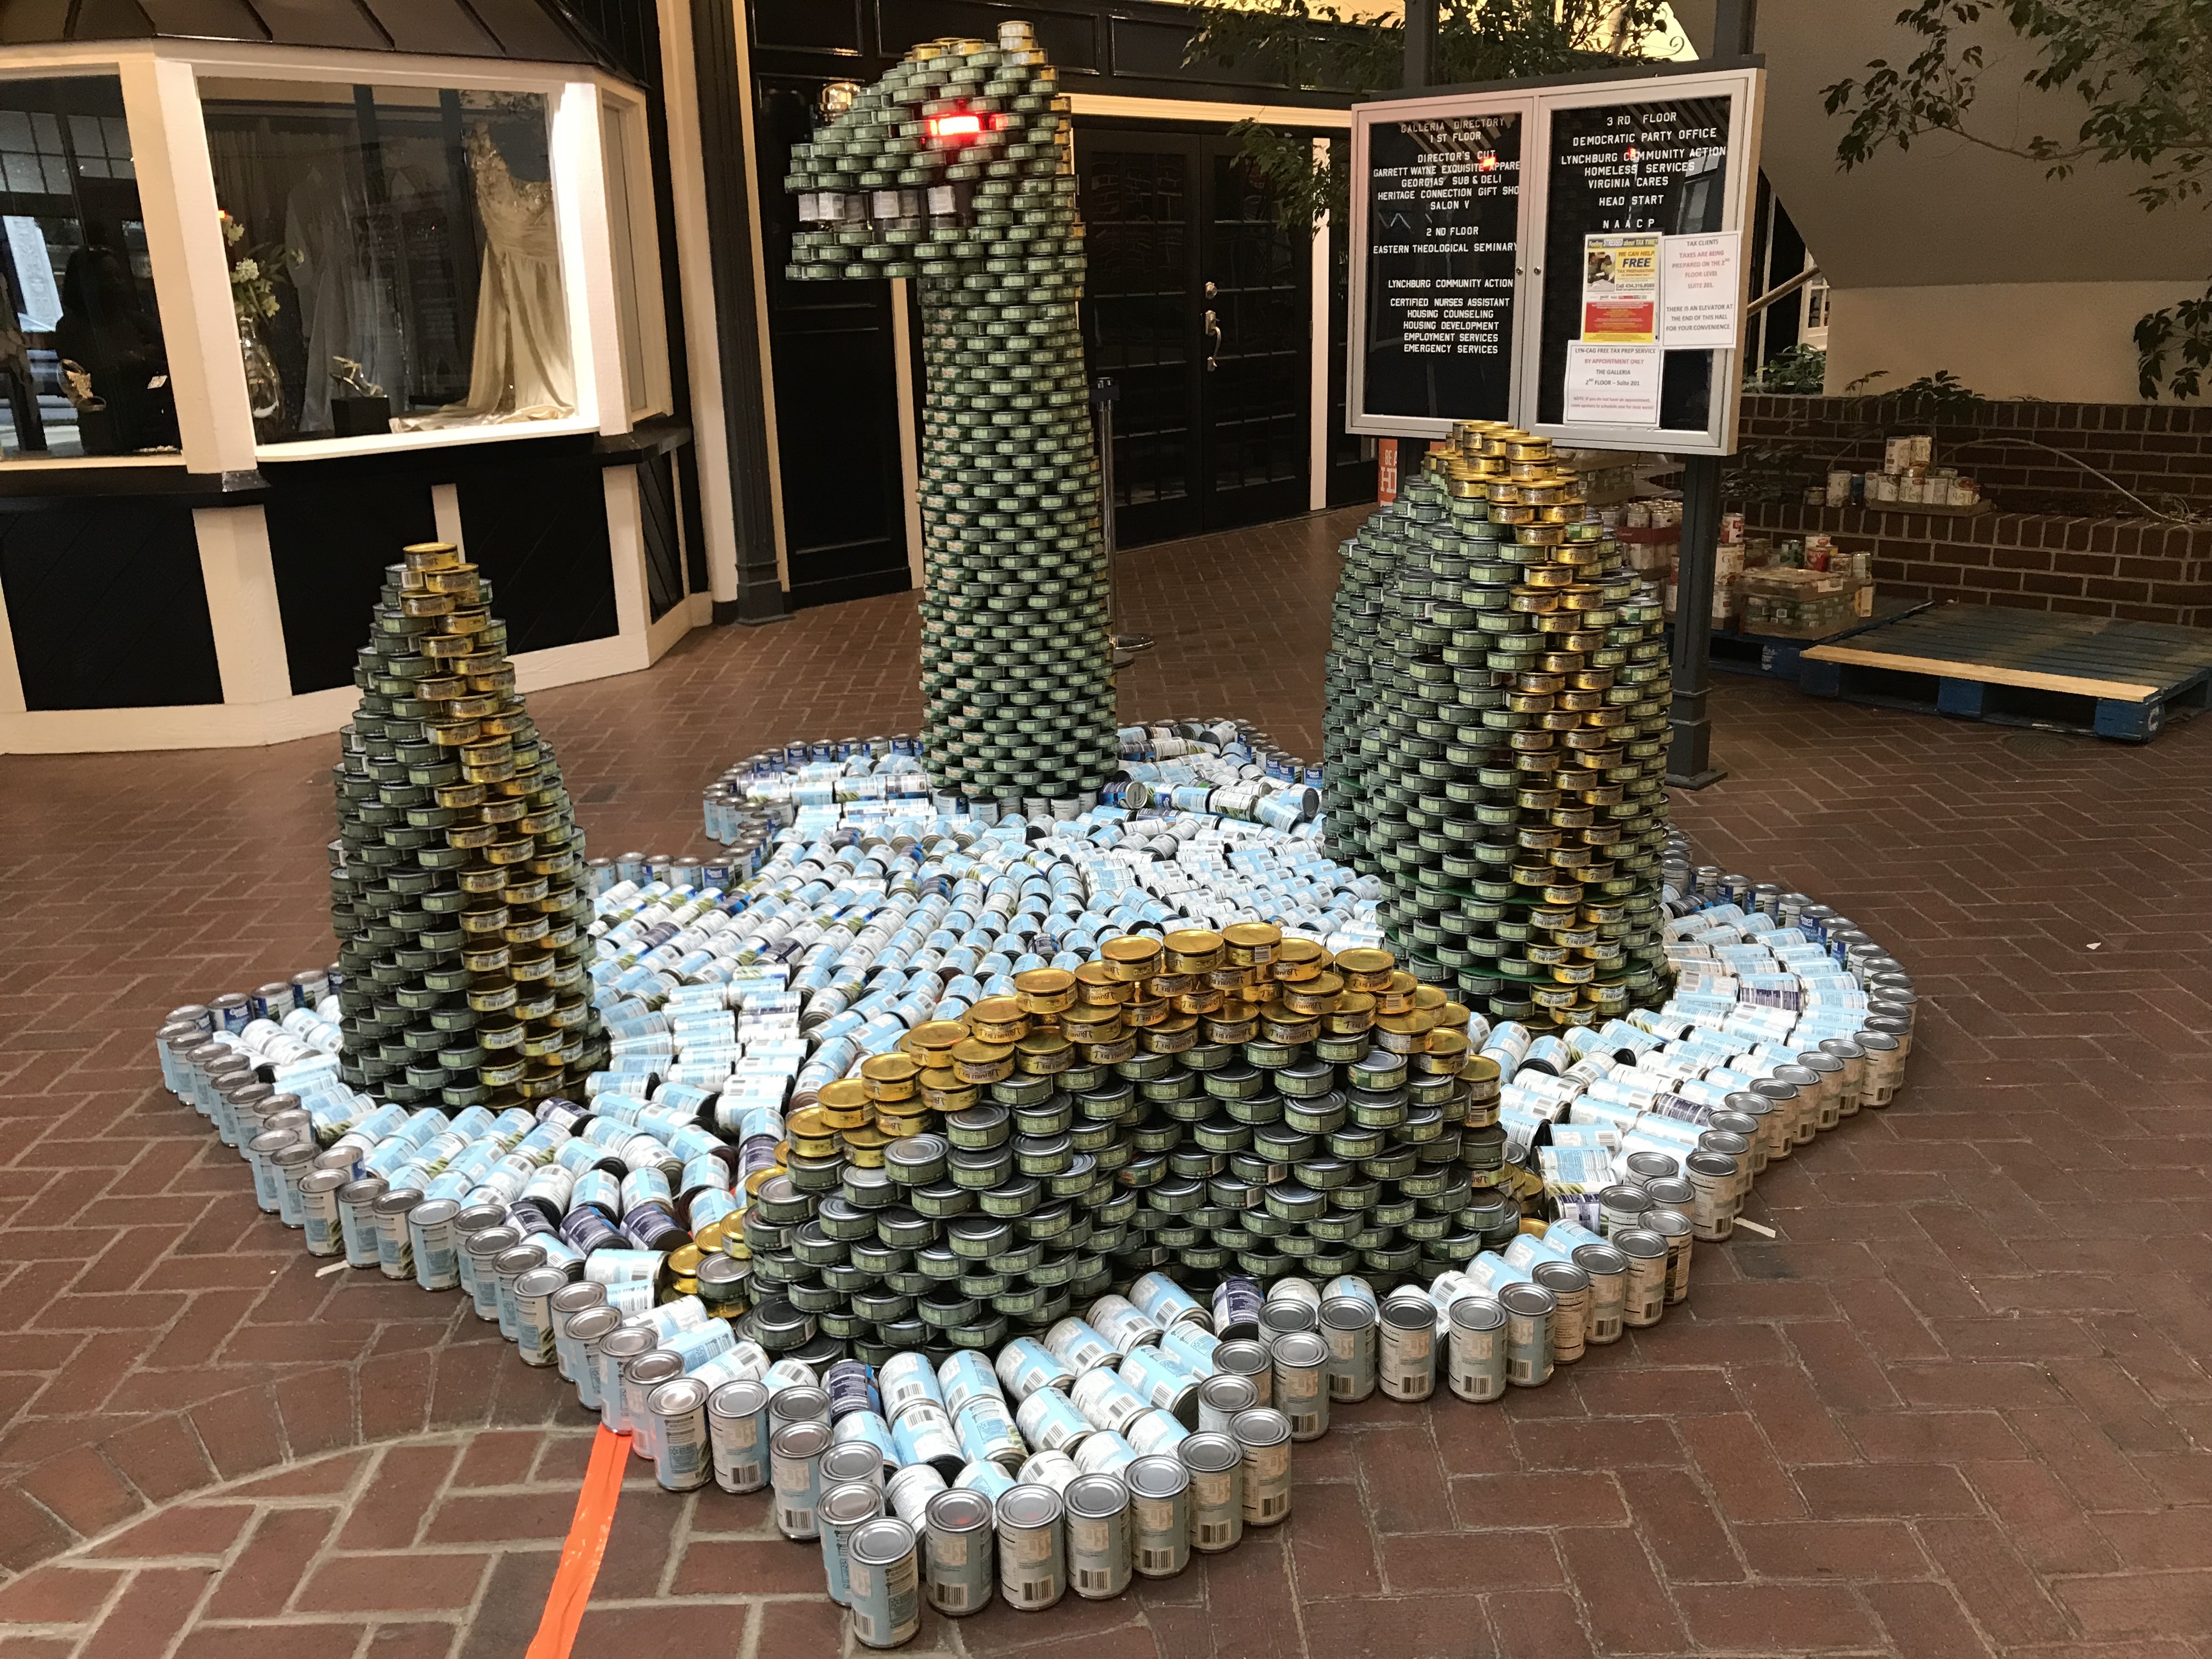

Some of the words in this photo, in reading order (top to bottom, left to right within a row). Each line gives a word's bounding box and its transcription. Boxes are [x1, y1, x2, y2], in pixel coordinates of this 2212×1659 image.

[1401, 122, 1444, 133] GALLERIA
[1454, 117, 1504, 129] DIRECTORY
[1607, 117, 1613, 126] 3
[1618, 116, 1630, 125] RD
[1643, 112, 1677, 124] FLOOR
[1437, 134, 1447, 143] ST
[1453, 131, 1481, 142] FLOOR
[1573, 134, 1635, 146] DEMOCRATIC
[1641, 131, 1672, 142] PARTY
[1679, 128, 1717, 139] OFFICE
[1418, 151, 1470, 163] DIRECTOR'S
[1477, 150, 1496, 160] CUT
[1561, 153, 1618, 165] LYNCHBURG
[1623, 149, 1685, 161] COMMUNITY
[1690, 146, 1726, 157] ACTION
[1374, 167, 1408, 177] GARRETT
[1410, 166, 1436, 175] WAYNE
[1442, 163, 1485, 173] EXQUISITE
[1585, 165, 1638, 176] HOMELESS
[1646, 162, 1695, 173] SERVICES
[1402, 177, 1443, 188] GEORGIAS
[1453, 176, 1469, 185] SUB
[1472, 176, 1478, 184] &
[1481, 174, 1501, 183] DELI
[1588, 178, 1630, 189] VIRGINIA
[1637, 176, 1668, 187] CARES
[1378, 191, 1415, 200] HERITAGE
[1421, 188, 1471, 199] CONNECTION
[1478, 187, 1497, 196] GIFT
[1431, 201, 1459, 210] SALON
[1465, 200, 1469, 208] V
[1599, 196, 1624, 206] HEAD
[1632, 195, 1664, 205] START
[1426, 228, 1431, 236] 2
[1436, 227, 1446, 236] ND
[1450, 226, 1479, 235] FLOOR
[1373, 245, 1409, 253] EASTERN
[1412, 244, 1468, 253] THEOLOGICAL
[1622, 258, 1651, 268] FREE
[1436, 279, 1481, 287] COMMUNITY
[1485, 279, 1513, 287] ACTION
[1467, 298, 1510, 307] ASSISTANT
[1408, 309, 1438, 318] HOUSING
[1444, 310, 1493, 318] COUNSELING
[1441, 321, 1499, 330] DEVELOPMENT
[1404, 333, 1455, 341] EMPLOYMENT
[1459, 334, 1498, 342] SERVICES
[1404, 345, 1451, 353] EMERGENCY
[1457, 345, 1498, 353] SERVICES
[1385, 450, 1392, 465] BE
